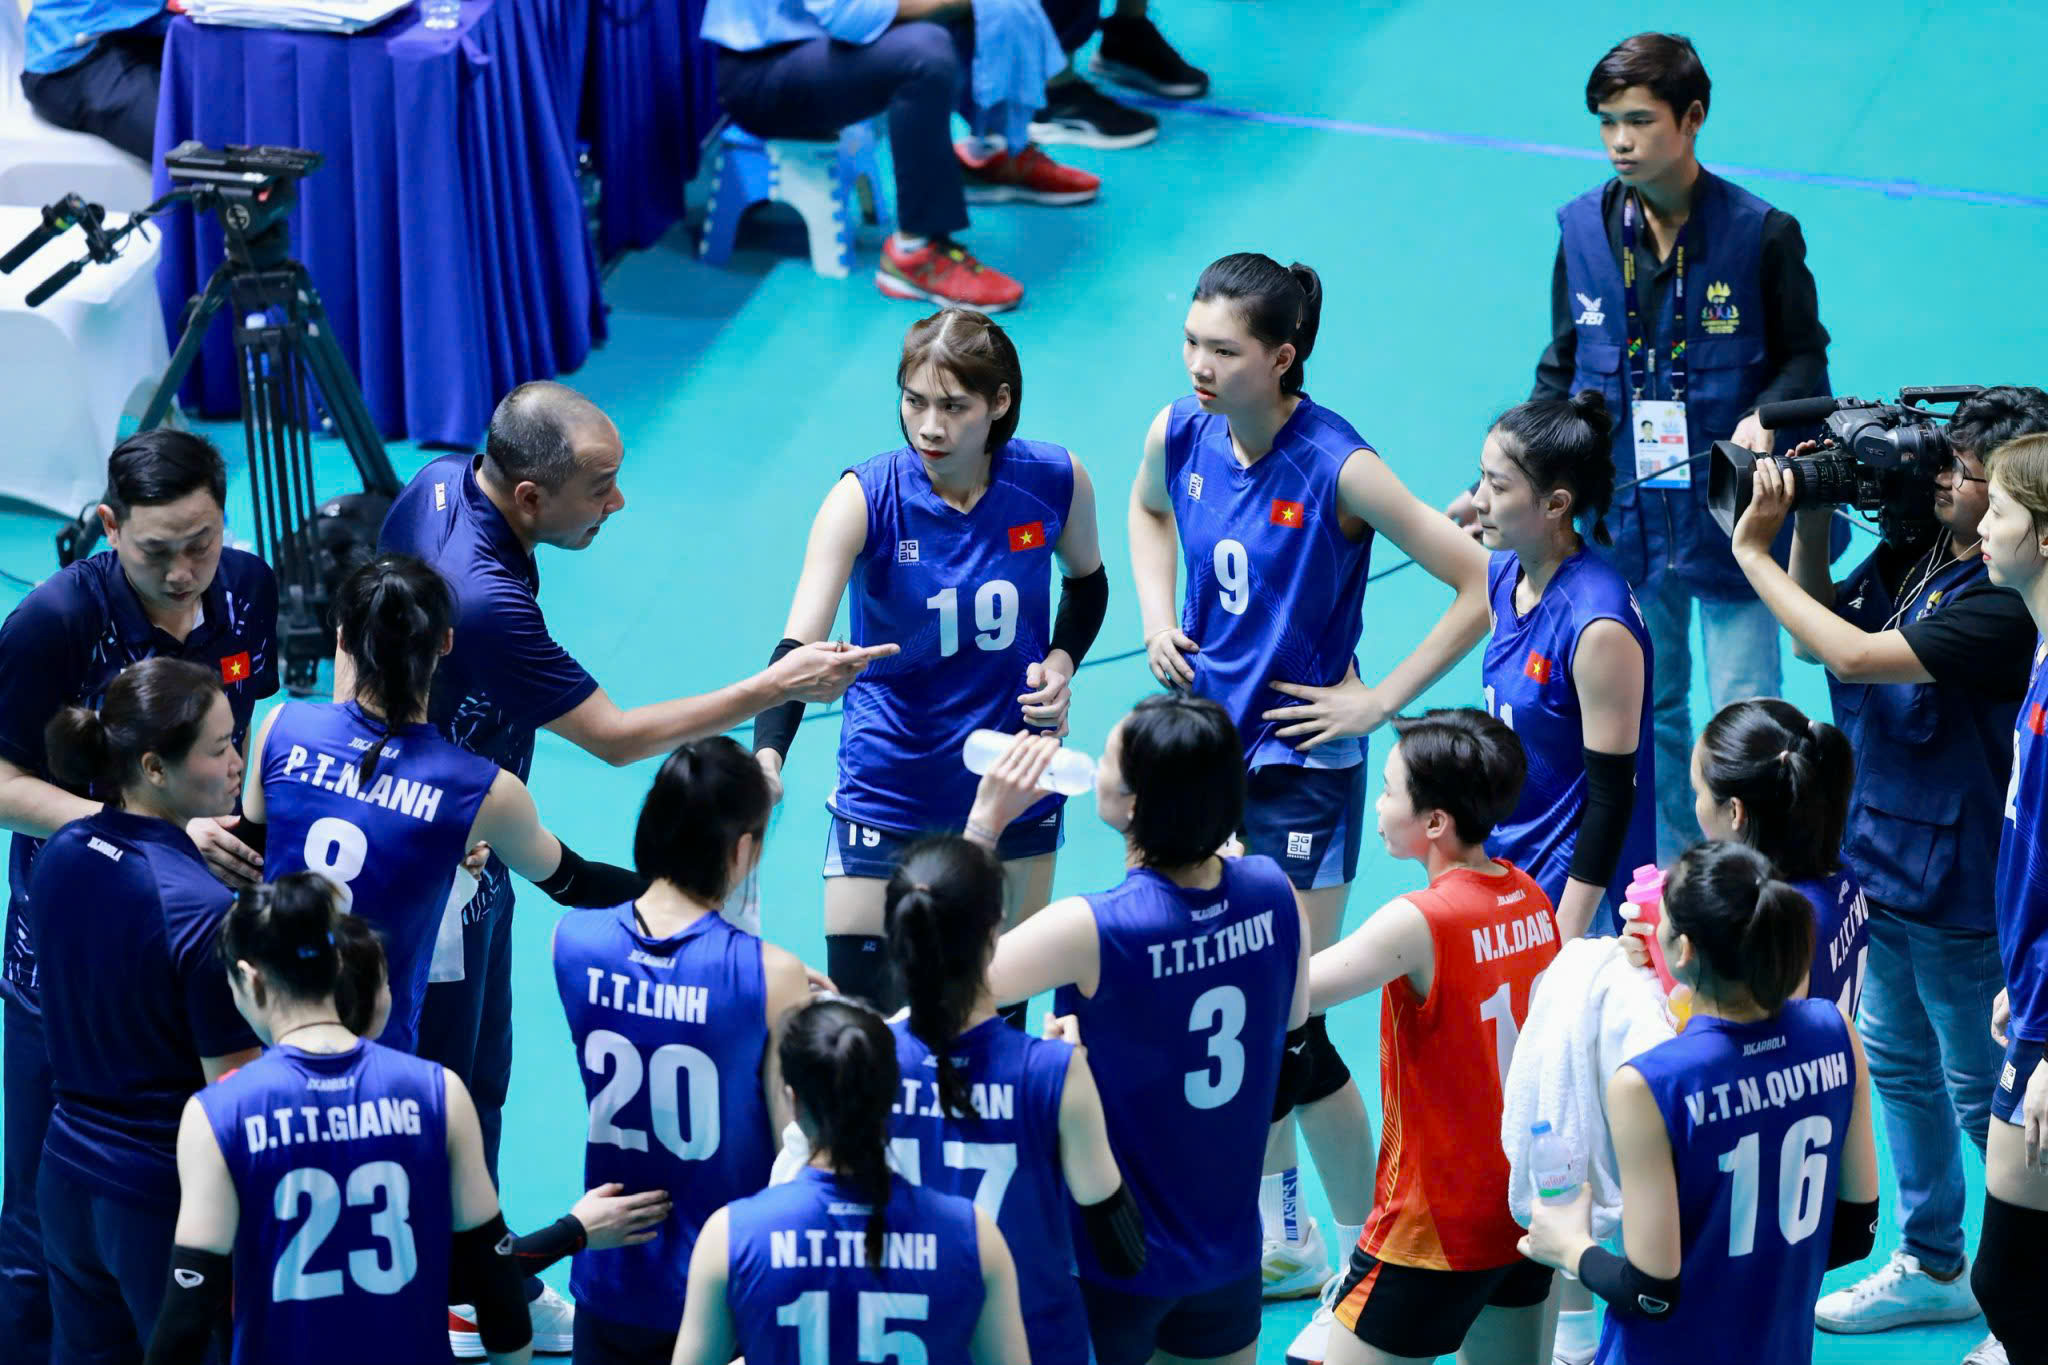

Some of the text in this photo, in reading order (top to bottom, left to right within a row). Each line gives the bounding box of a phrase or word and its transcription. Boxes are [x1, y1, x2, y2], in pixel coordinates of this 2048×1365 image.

[1213, 538, 1250, 615] 9
[926, 579, 1020, 657] 19
[283, 744, 445, 823] P.T.N.ANH
[303, 816, 368, 917] 8
[1147, 910, 1275, 979] T.T.T.THUY
[586, 966, 710, 1025] T.T.LINH
[1183, 985, 1247, 1110] 3
[244, 1097, 423, 1154] D.T.T.GIANG
[584, 1028, 721, 1162] 20
[1684, 1051, 1849, 1127] V.T.N.QUYNH
[1717, 1114, 1833, 1258] 16
[271, 1160, 419, 1303] 23
[776, 1290, 930, 1365] 15
